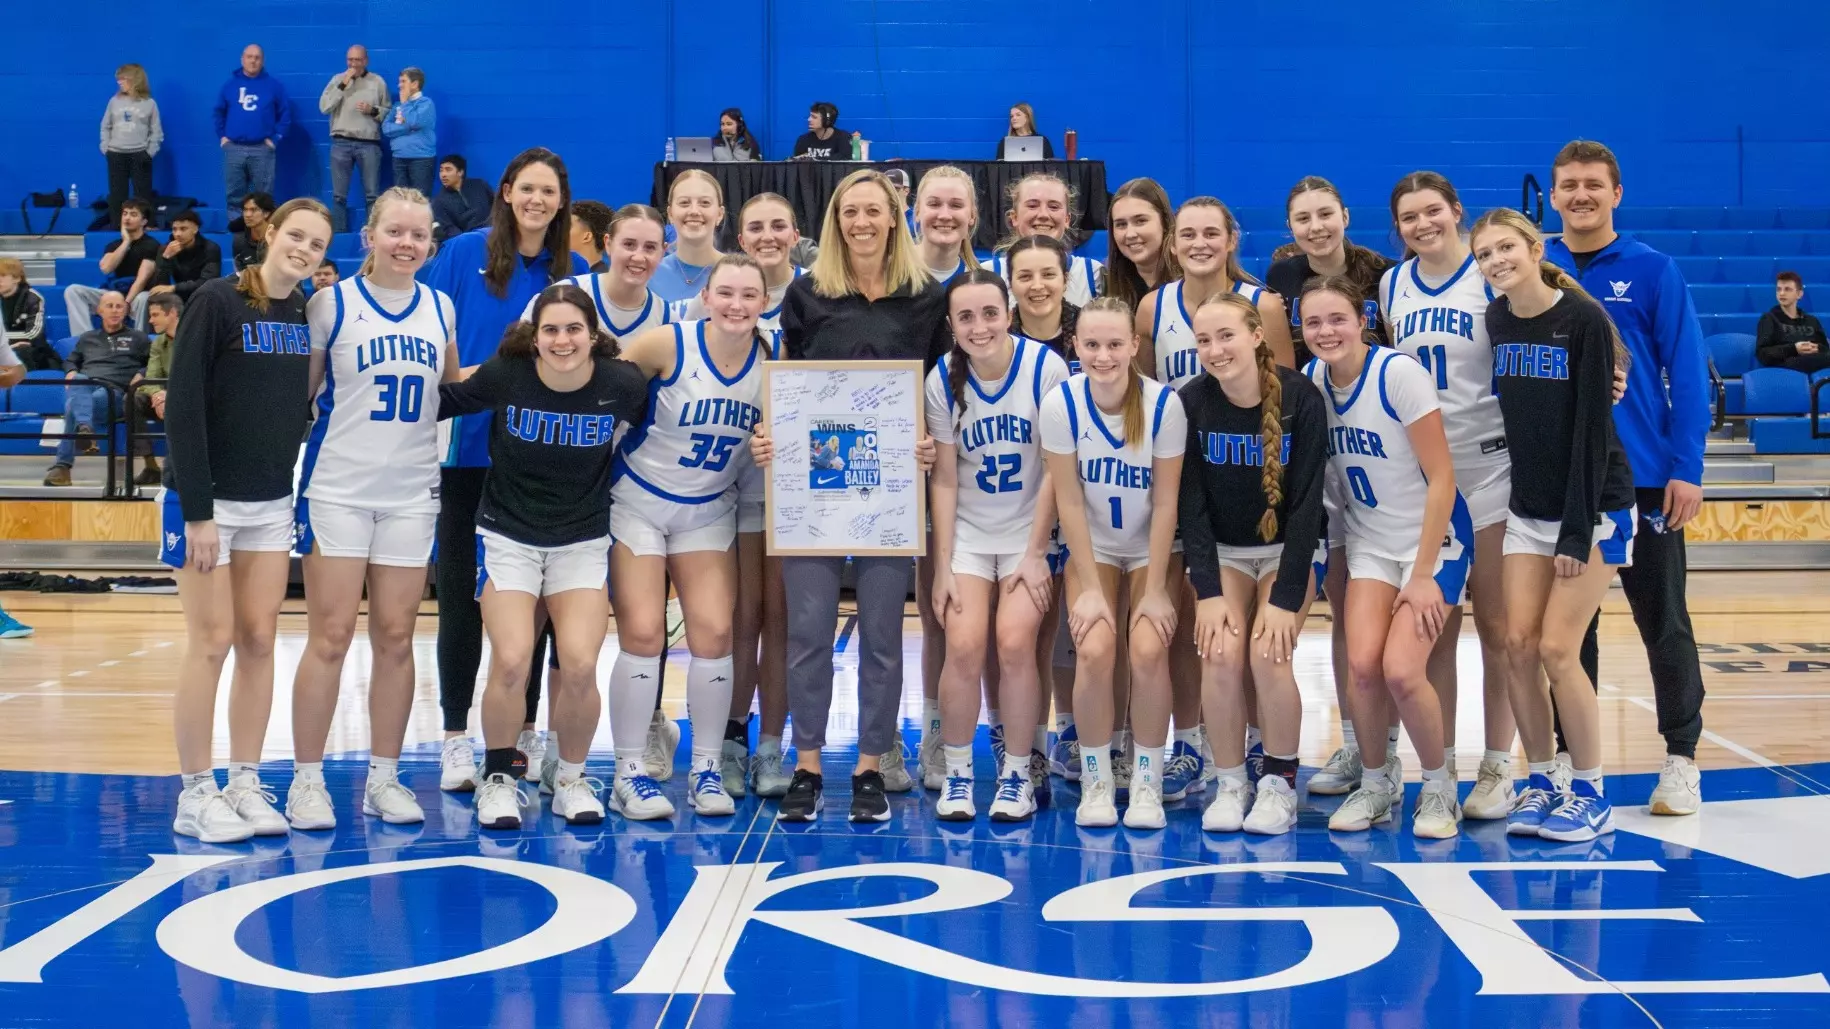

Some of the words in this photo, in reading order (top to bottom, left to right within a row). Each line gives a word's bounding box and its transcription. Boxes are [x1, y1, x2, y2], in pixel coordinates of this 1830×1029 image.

[238, 87, 259, 112] LC
[242, 321, 312, 356] LUTHE
[1396, 307, 1474, 346] LUTHER
[357, 334, 439, 373] LUTHER
[1165, 348, 1206, 383] LUT
[1417, 344, 1448, 390] 11
[1493, 343, 1570, 380] UTHER
[370, 375, 424, 422] 30
[678, 398, 761, 434] LUTHER
[506, 404, 615, 446] LUTHER
[817, 423, 856, 434] WINS
[962, 413, 1033, 452] LUTHER
[1328, 425, 1388, 459] UTHER
[678, 432, 743, 472] 35
[844, 470, 880, 486] BAILEY
[975, 453, 1023, 494] 22
[1079, 456, 1153, 490] LUTHER
[1346, 466, 1378, 508] 0
[1108, 496, 1123, 529] 1
